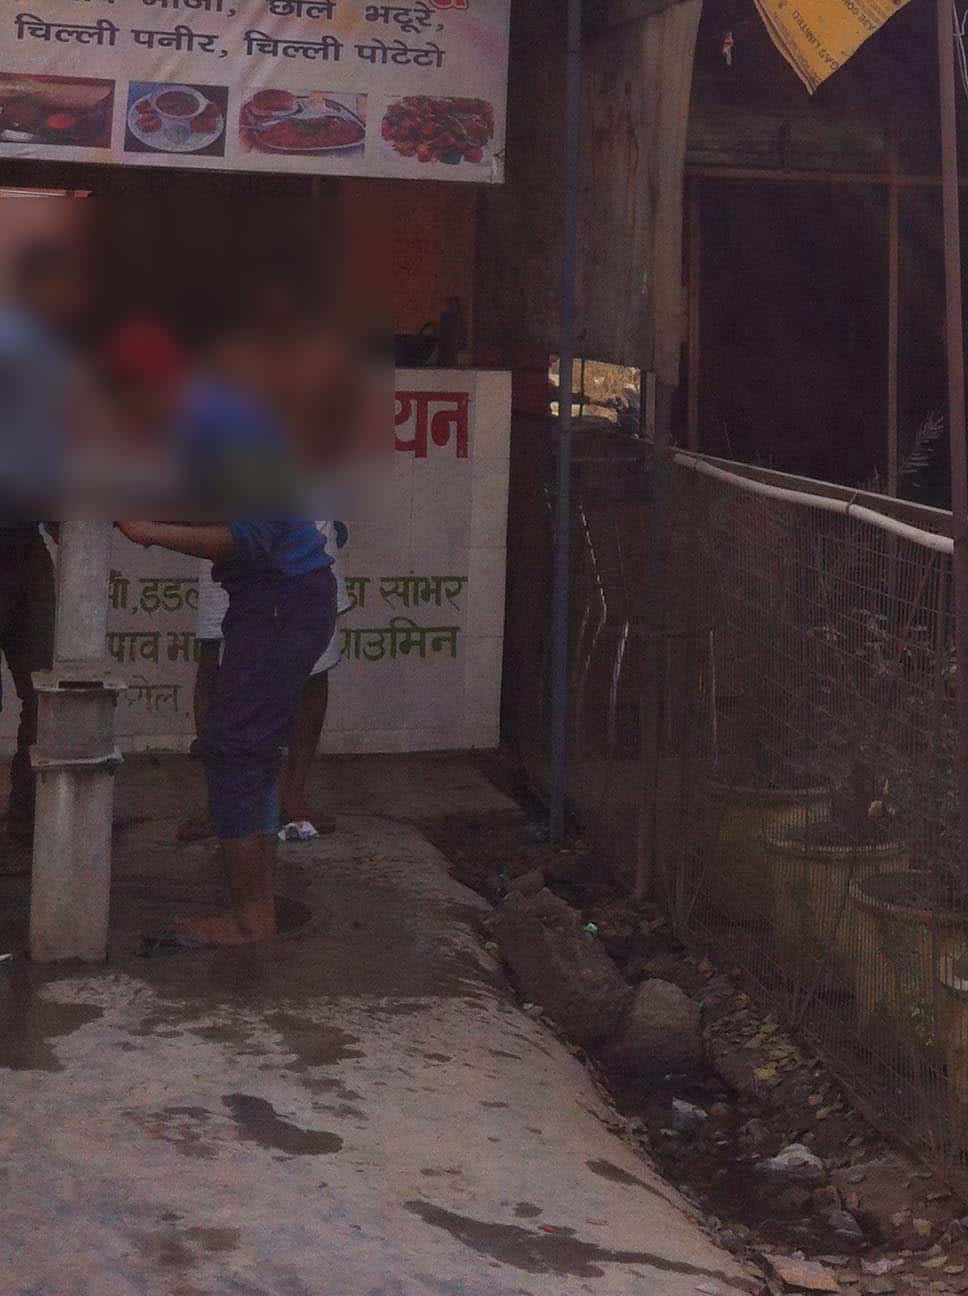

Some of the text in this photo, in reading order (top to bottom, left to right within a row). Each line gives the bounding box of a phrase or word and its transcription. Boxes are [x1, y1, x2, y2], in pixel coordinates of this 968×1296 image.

[15, 12, 446, 68] चिल्ली पनीर, चिल्ली पोटेटो
